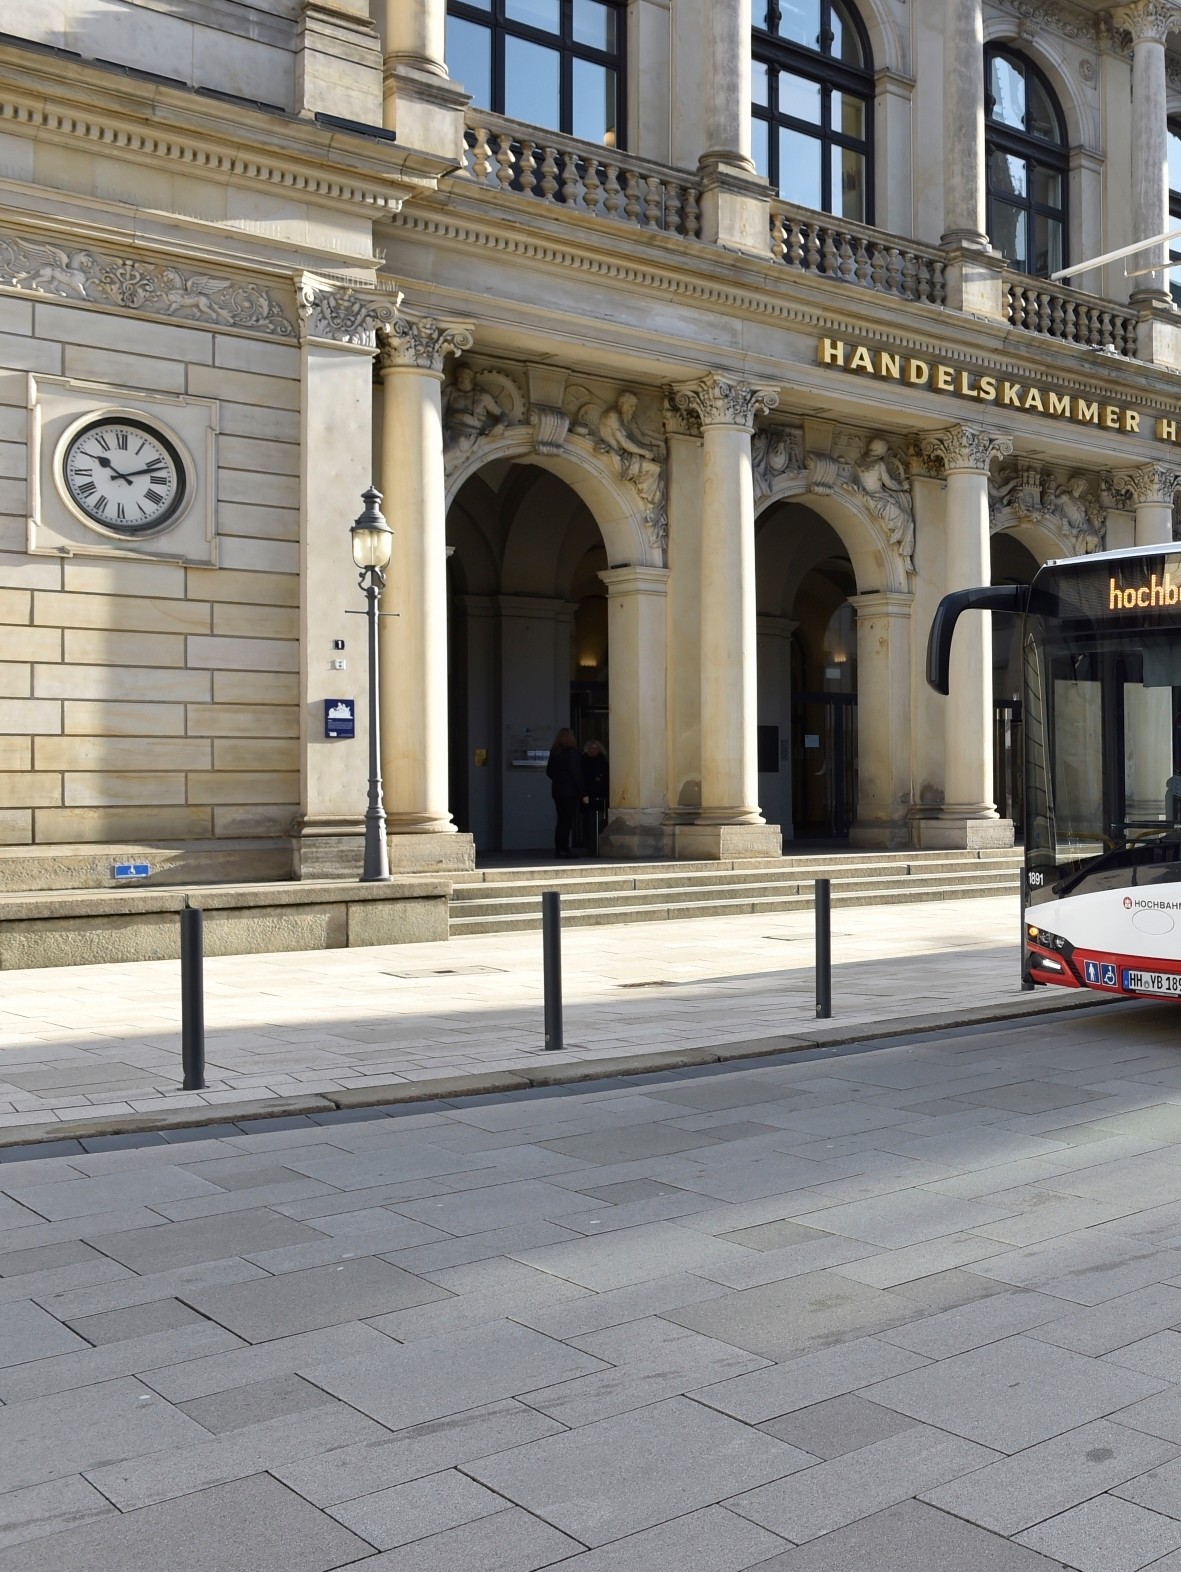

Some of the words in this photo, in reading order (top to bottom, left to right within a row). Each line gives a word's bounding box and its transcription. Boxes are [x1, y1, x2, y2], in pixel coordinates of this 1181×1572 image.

[819, 338, 1141, 434] HANDELSKAMMER
[1028, 871, 1044, 886] 1891
[1130, 973, 1143, 988] HH
[1150, 974, 1163, 989] YB
